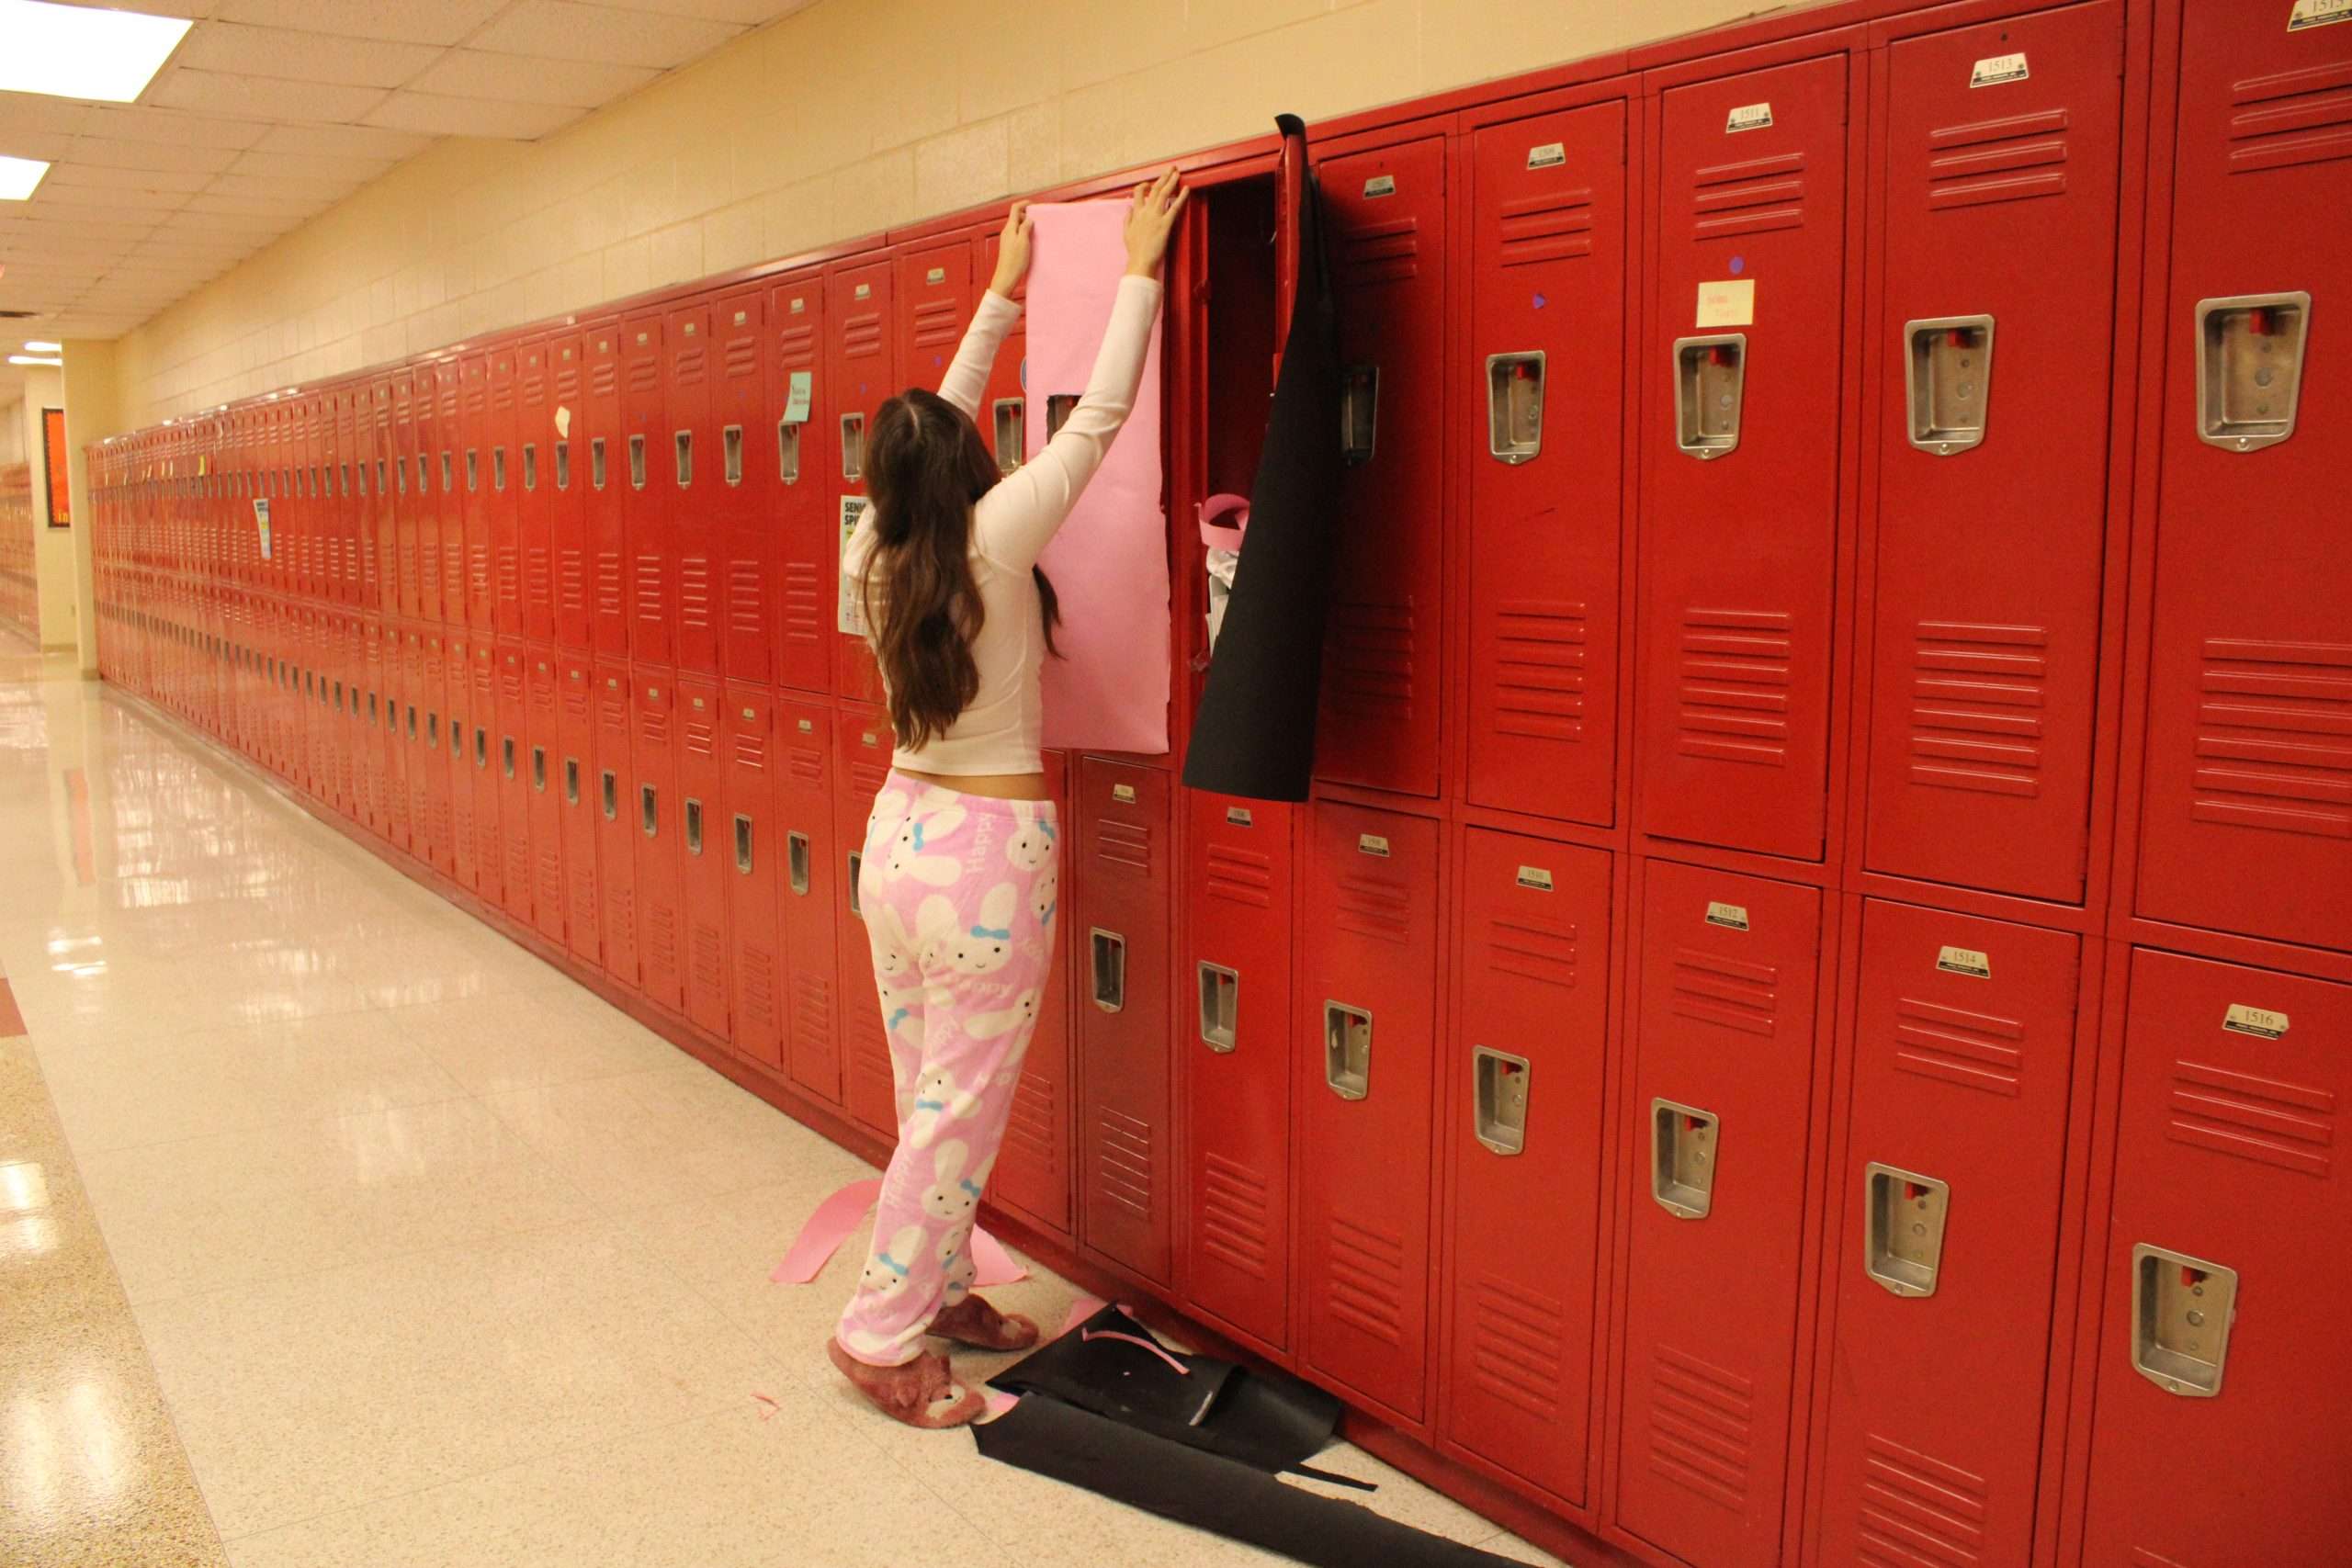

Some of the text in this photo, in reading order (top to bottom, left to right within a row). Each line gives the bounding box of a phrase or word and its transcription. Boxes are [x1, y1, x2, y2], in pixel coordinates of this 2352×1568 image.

[1988, 58, 2013, 73] 1513
[1953, 951, 1976, 964] 1514
[2245, 1010, 2274, 1026] 1516
